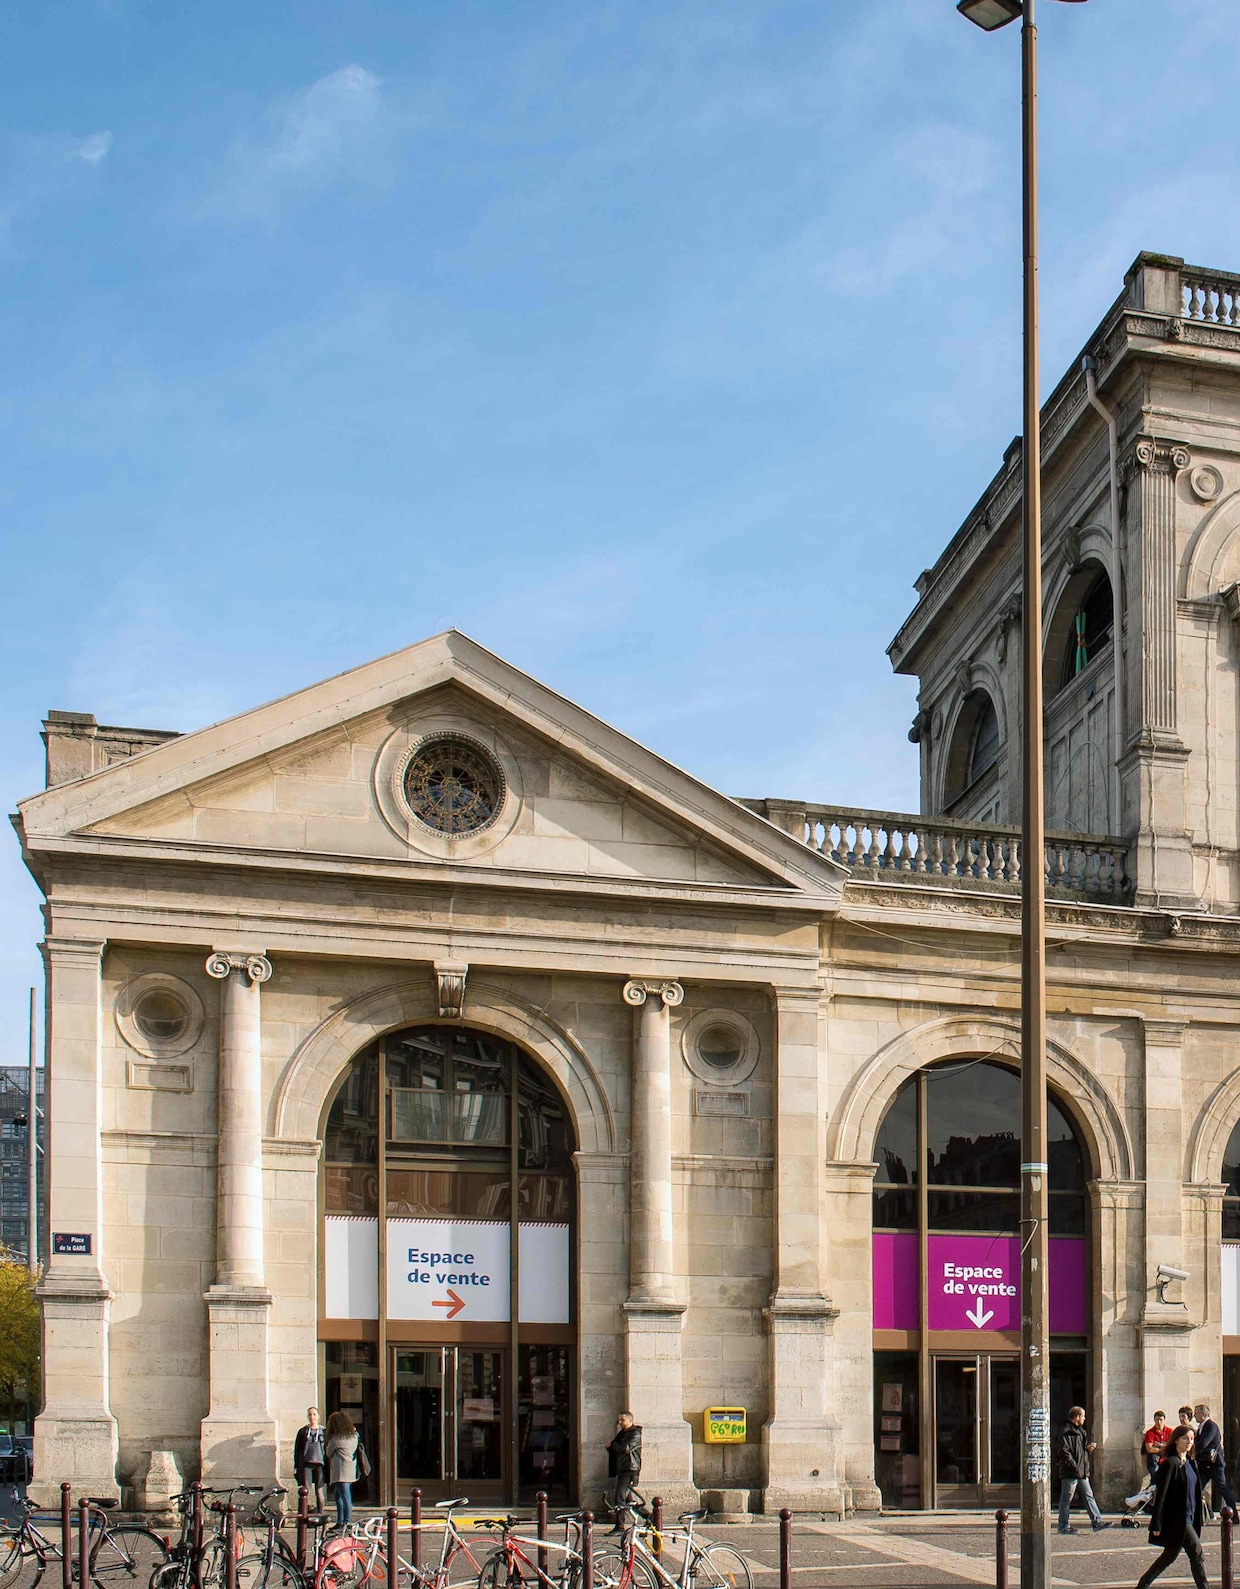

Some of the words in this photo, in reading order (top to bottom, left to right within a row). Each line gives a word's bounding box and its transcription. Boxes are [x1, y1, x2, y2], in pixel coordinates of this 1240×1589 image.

[408, 1248, 474, 1267] Espace
[407, 1268, 430, 1283] de
[436, 1272, 490, 1286] vente
[943, 1263, 1003, 1281] Espace
[943, 1279, 965, 1294] de
[968, 1282, 1017, 1296] vente
